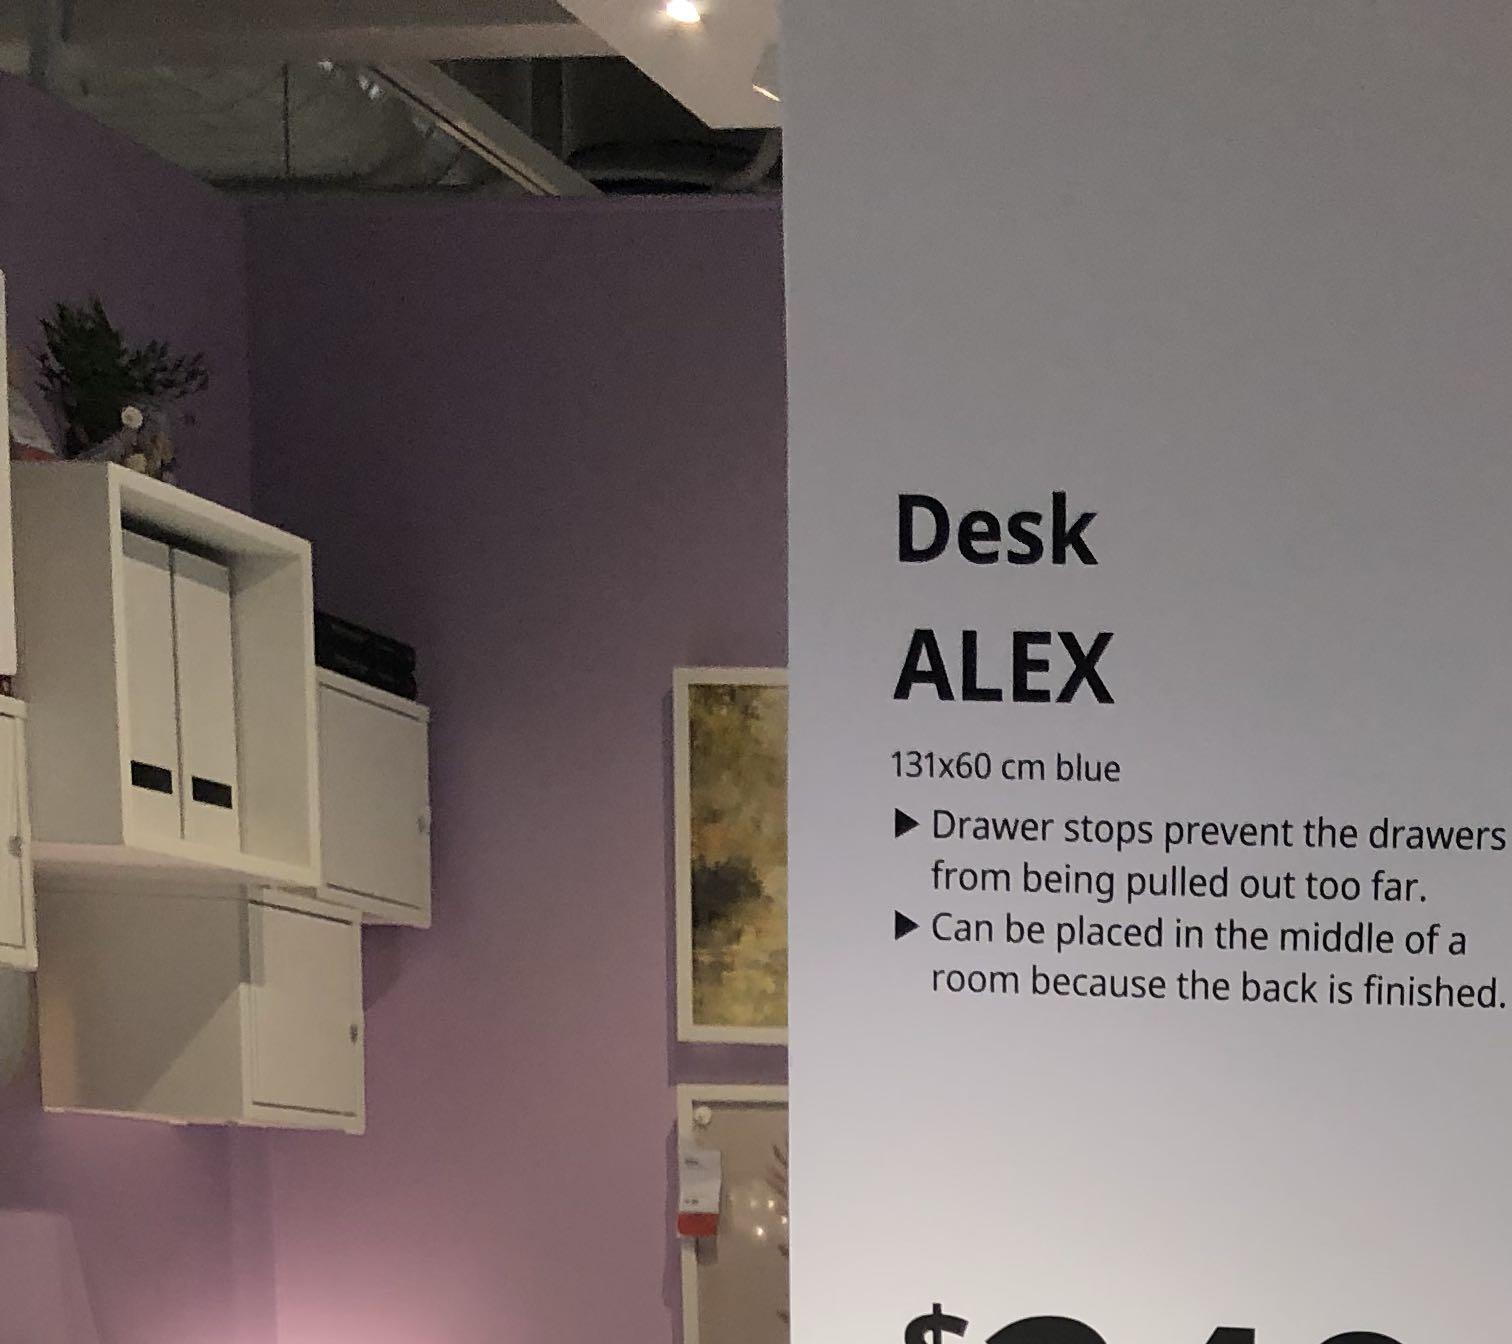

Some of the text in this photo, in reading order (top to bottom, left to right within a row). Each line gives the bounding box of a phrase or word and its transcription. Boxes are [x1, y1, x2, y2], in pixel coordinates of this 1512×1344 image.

[897, 491, 1099, 567] Desk
[892, 627, 1115, 705] ALEX
[890, 750, 1121, 784] 131x60 cm blue
[932, 809, 1507, 855] Drawer stops prevent the drawers
[931, 860, 1427, 905] from being pulled out too far.
[931, 912, 1466, 956] Can be placed in the middle of a
[932, 965, 1507, 1010] room because the back is finished.
